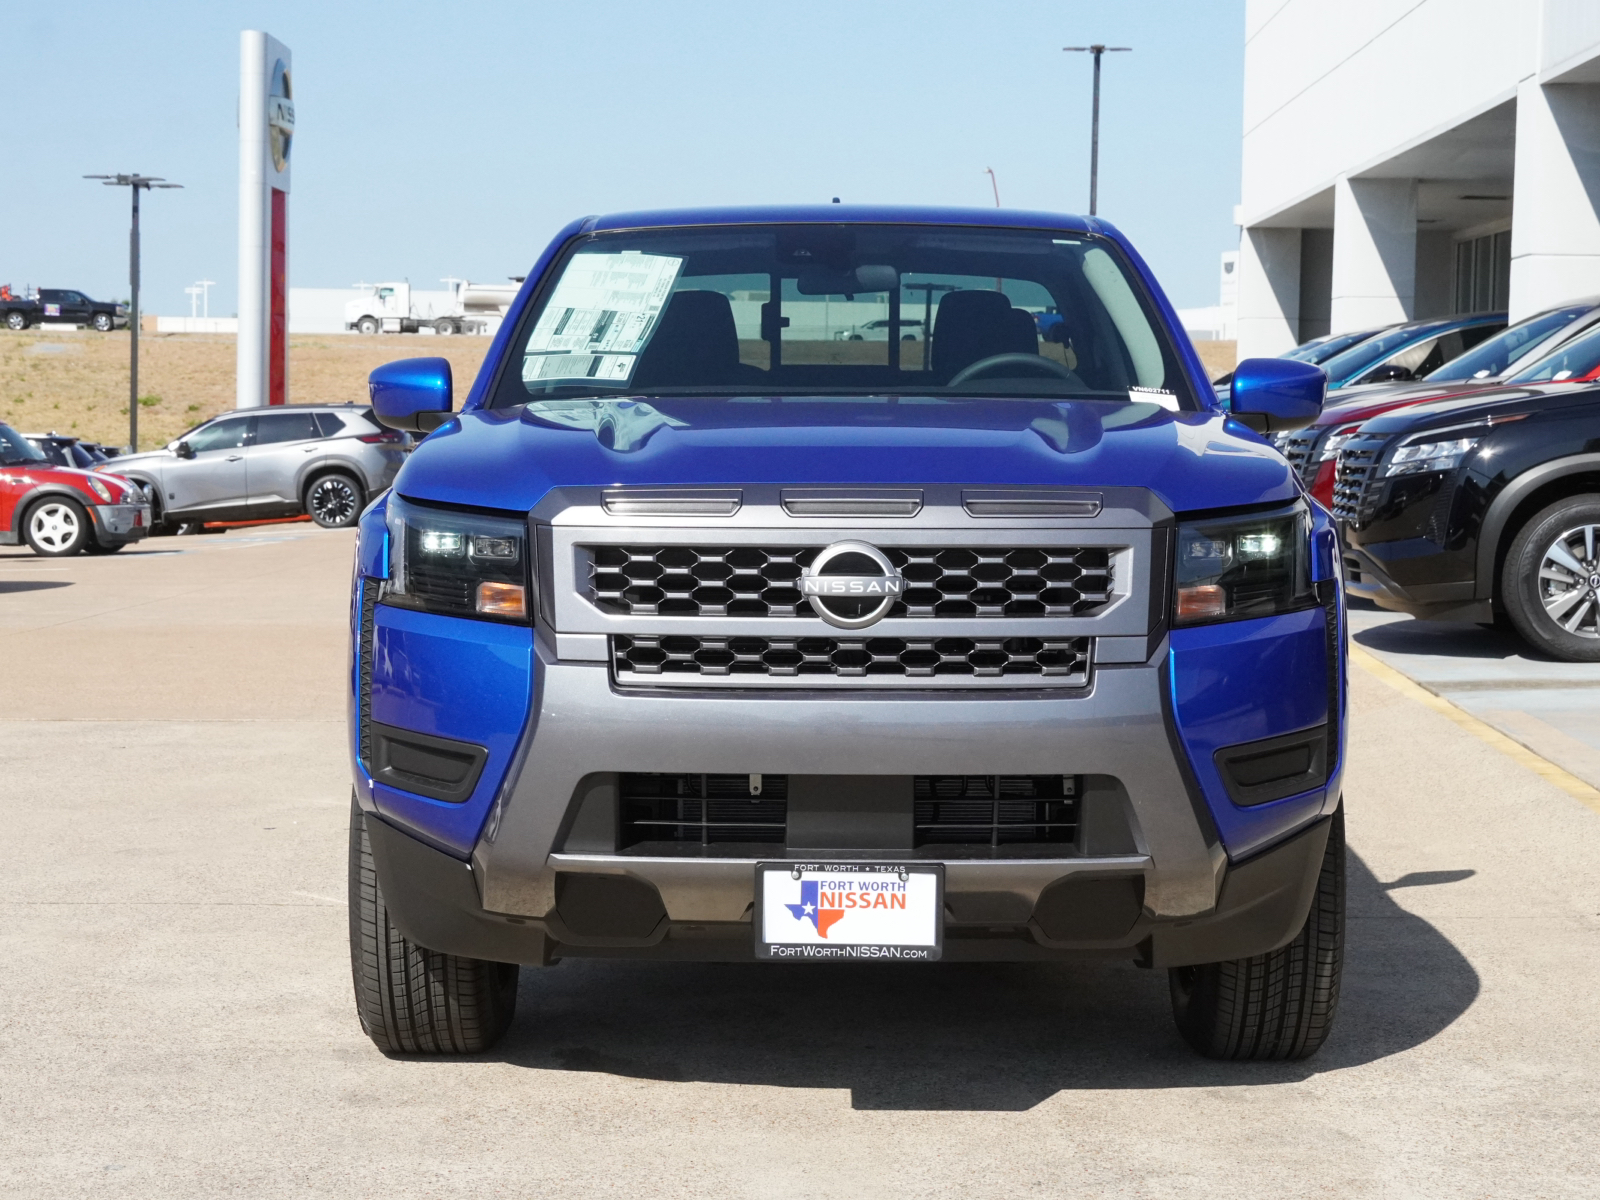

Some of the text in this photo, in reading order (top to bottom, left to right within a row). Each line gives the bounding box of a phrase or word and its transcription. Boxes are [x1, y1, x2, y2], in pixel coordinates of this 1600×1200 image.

[804, 580, 899, 593] NISSAN
[794, 864, 820, 872] FORT
[874, 865, 906, 873] TEXAS
[820, 880, 906, 892] FORT WORTH
[820, 892, 906, 909] NISSAN
